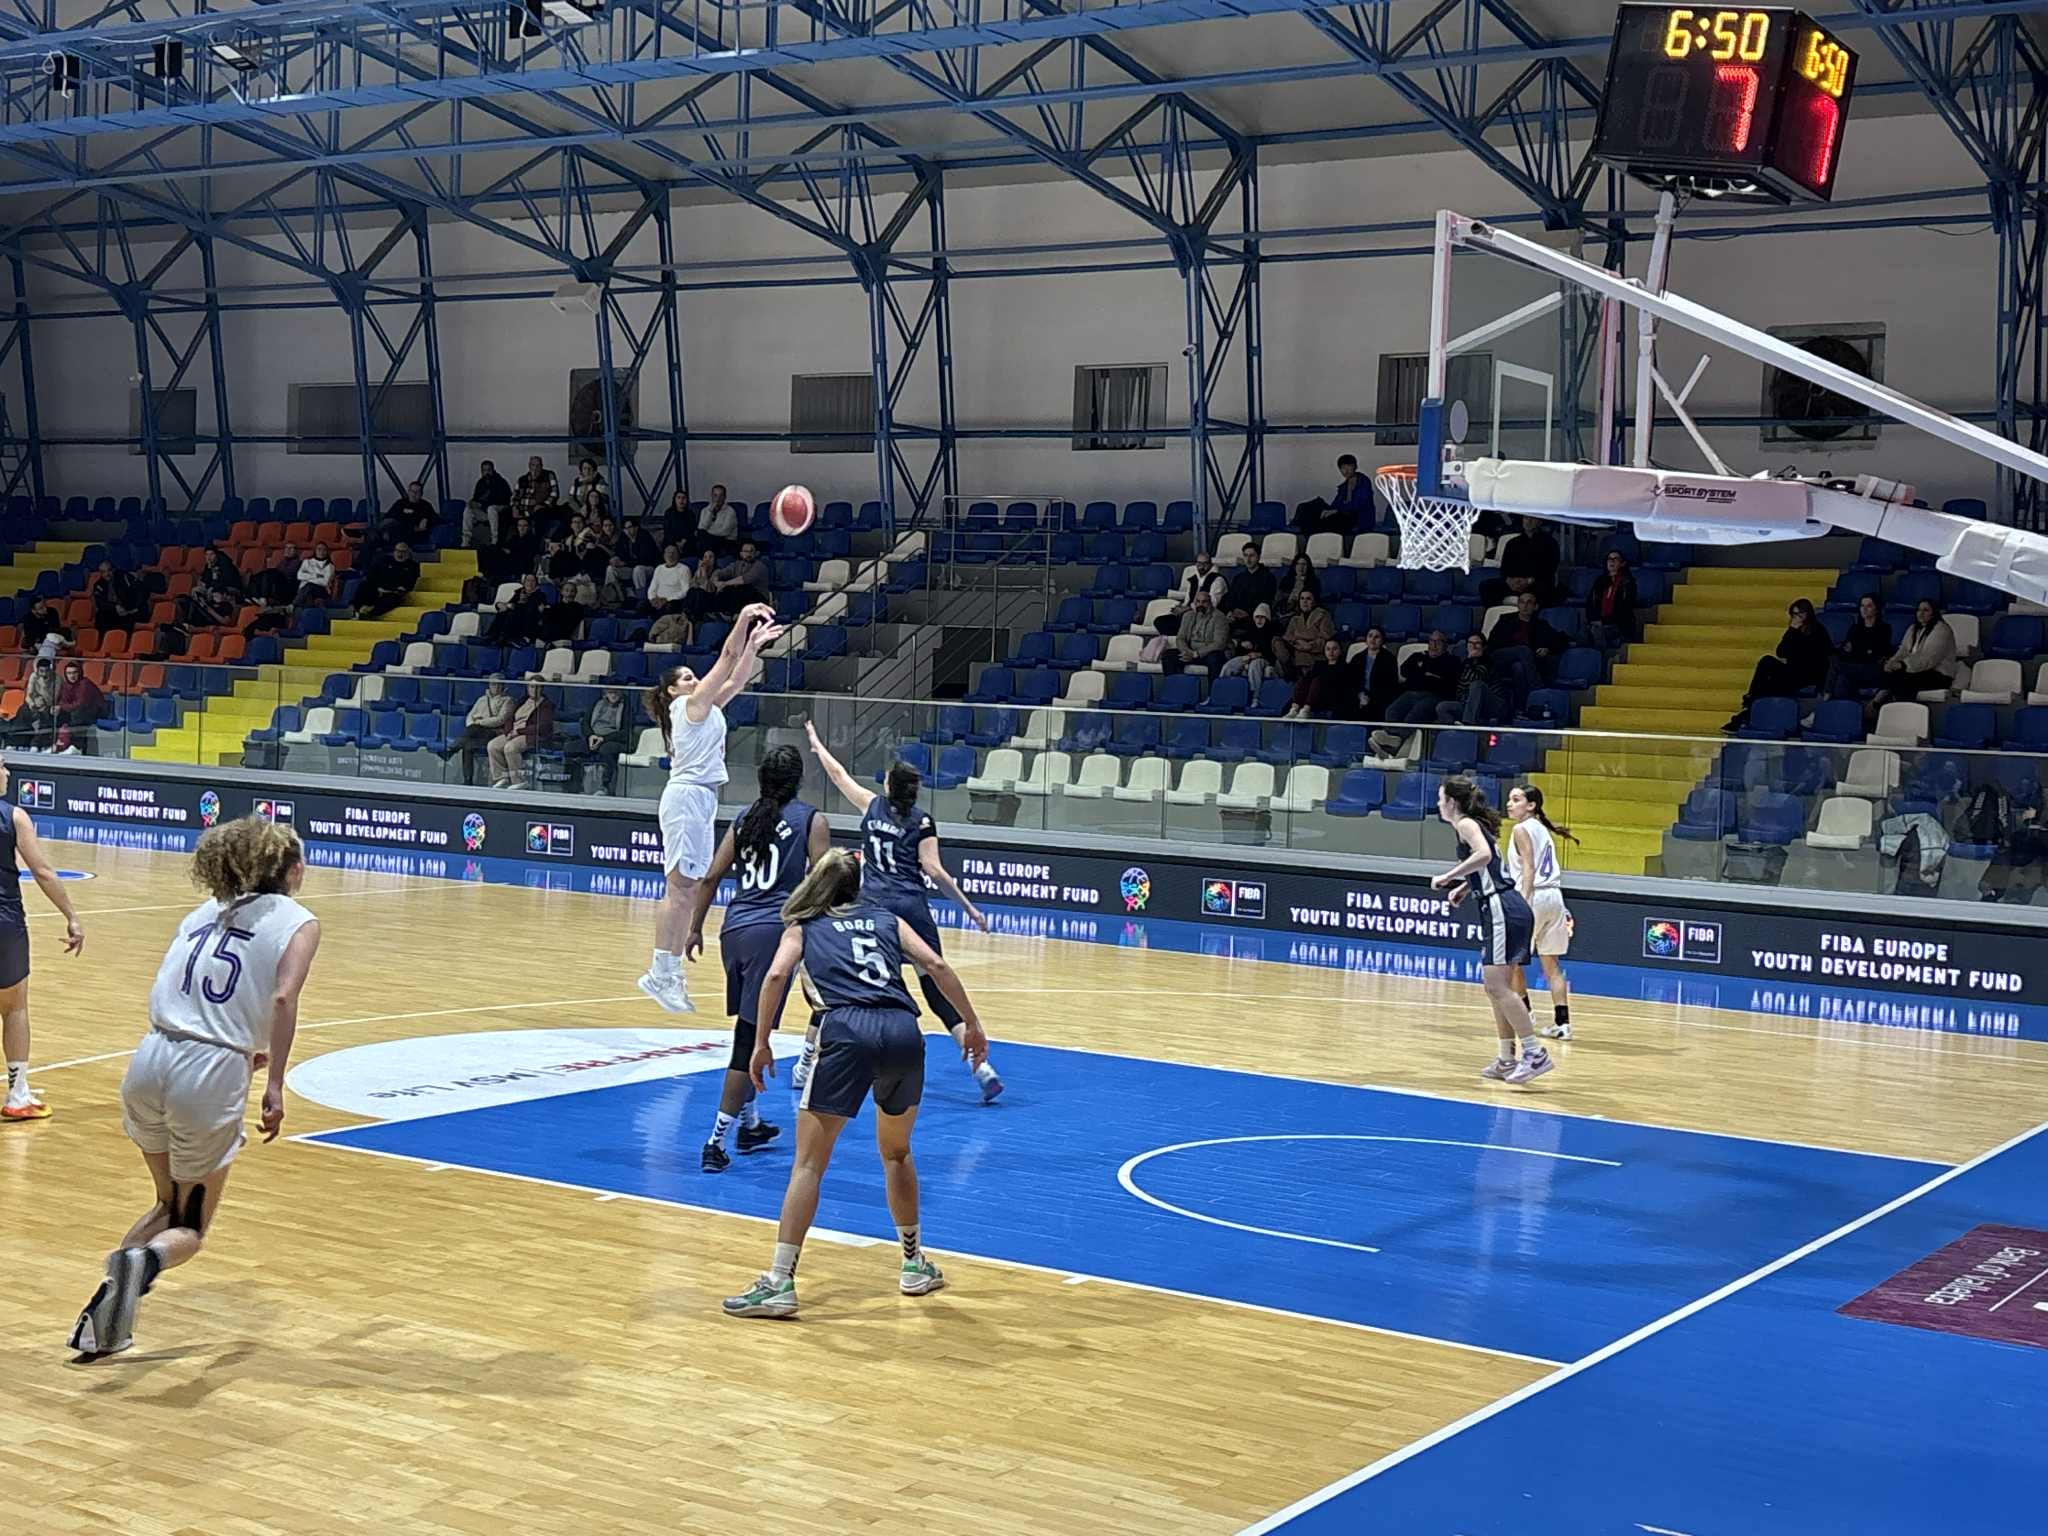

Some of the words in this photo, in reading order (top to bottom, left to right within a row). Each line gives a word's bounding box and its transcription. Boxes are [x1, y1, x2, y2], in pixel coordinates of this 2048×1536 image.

[1665, 10, 1769, 60] 6:50
[1804, 31, 1849, 98] 6:50
[1718, 67, 1759, 151] 7
[98, 786, 118, 799] FIBA
[120, 789, 155, 803] EUROPE
[67, 799, 95, 813] YOUTH
[98, 802, 159, 818] DEVELOPMENT
[163, 808, 187, 821] FUND
[345, 807, 369, 821] FIBA
[372, 810, 411, 825] EUROPE
[310, 820, 342, 835] YOUTH
[345, 824, 417, 842] DEVELOPMENT
[420, 830, 448, 845] FUND
[631, 831, 658, 846] FIBA
[590, 845, 627, 861] YOUTH
[869, 835, 898, 873] 11
[963, 859, 994, 875] FIBA
[998, 862, 1050, 880] EUROPE
[963, 878, 1058, 899] DEVELOPMENT
[1063, 886, 1099, 904] FUND
[1238, 886, 1261, 900] FIBA
[1346, 892, 1383, 910] FIBA
[1388, 895, 1451, 917] EUROPE
[831, 918, 876, 933] BORG
[1290, 907, 1340, 927] YOUTH
[1346, 912, 1460, 940] DEVELOPMENT
[1688, 927, 1715, 942] FIBA
[1821, 934, 1866, 954] FIBA
[1873, 938, 1949, 962] EUROPE
[181, 922, 256, 1004] 15
[851, 936, 891, 988] 5
[1751, 950, 1812, 973] YOUTH
[1821, 956, 1961, 987] DEVELOPMENT
[1968, 970, 2023, 992] FUND
